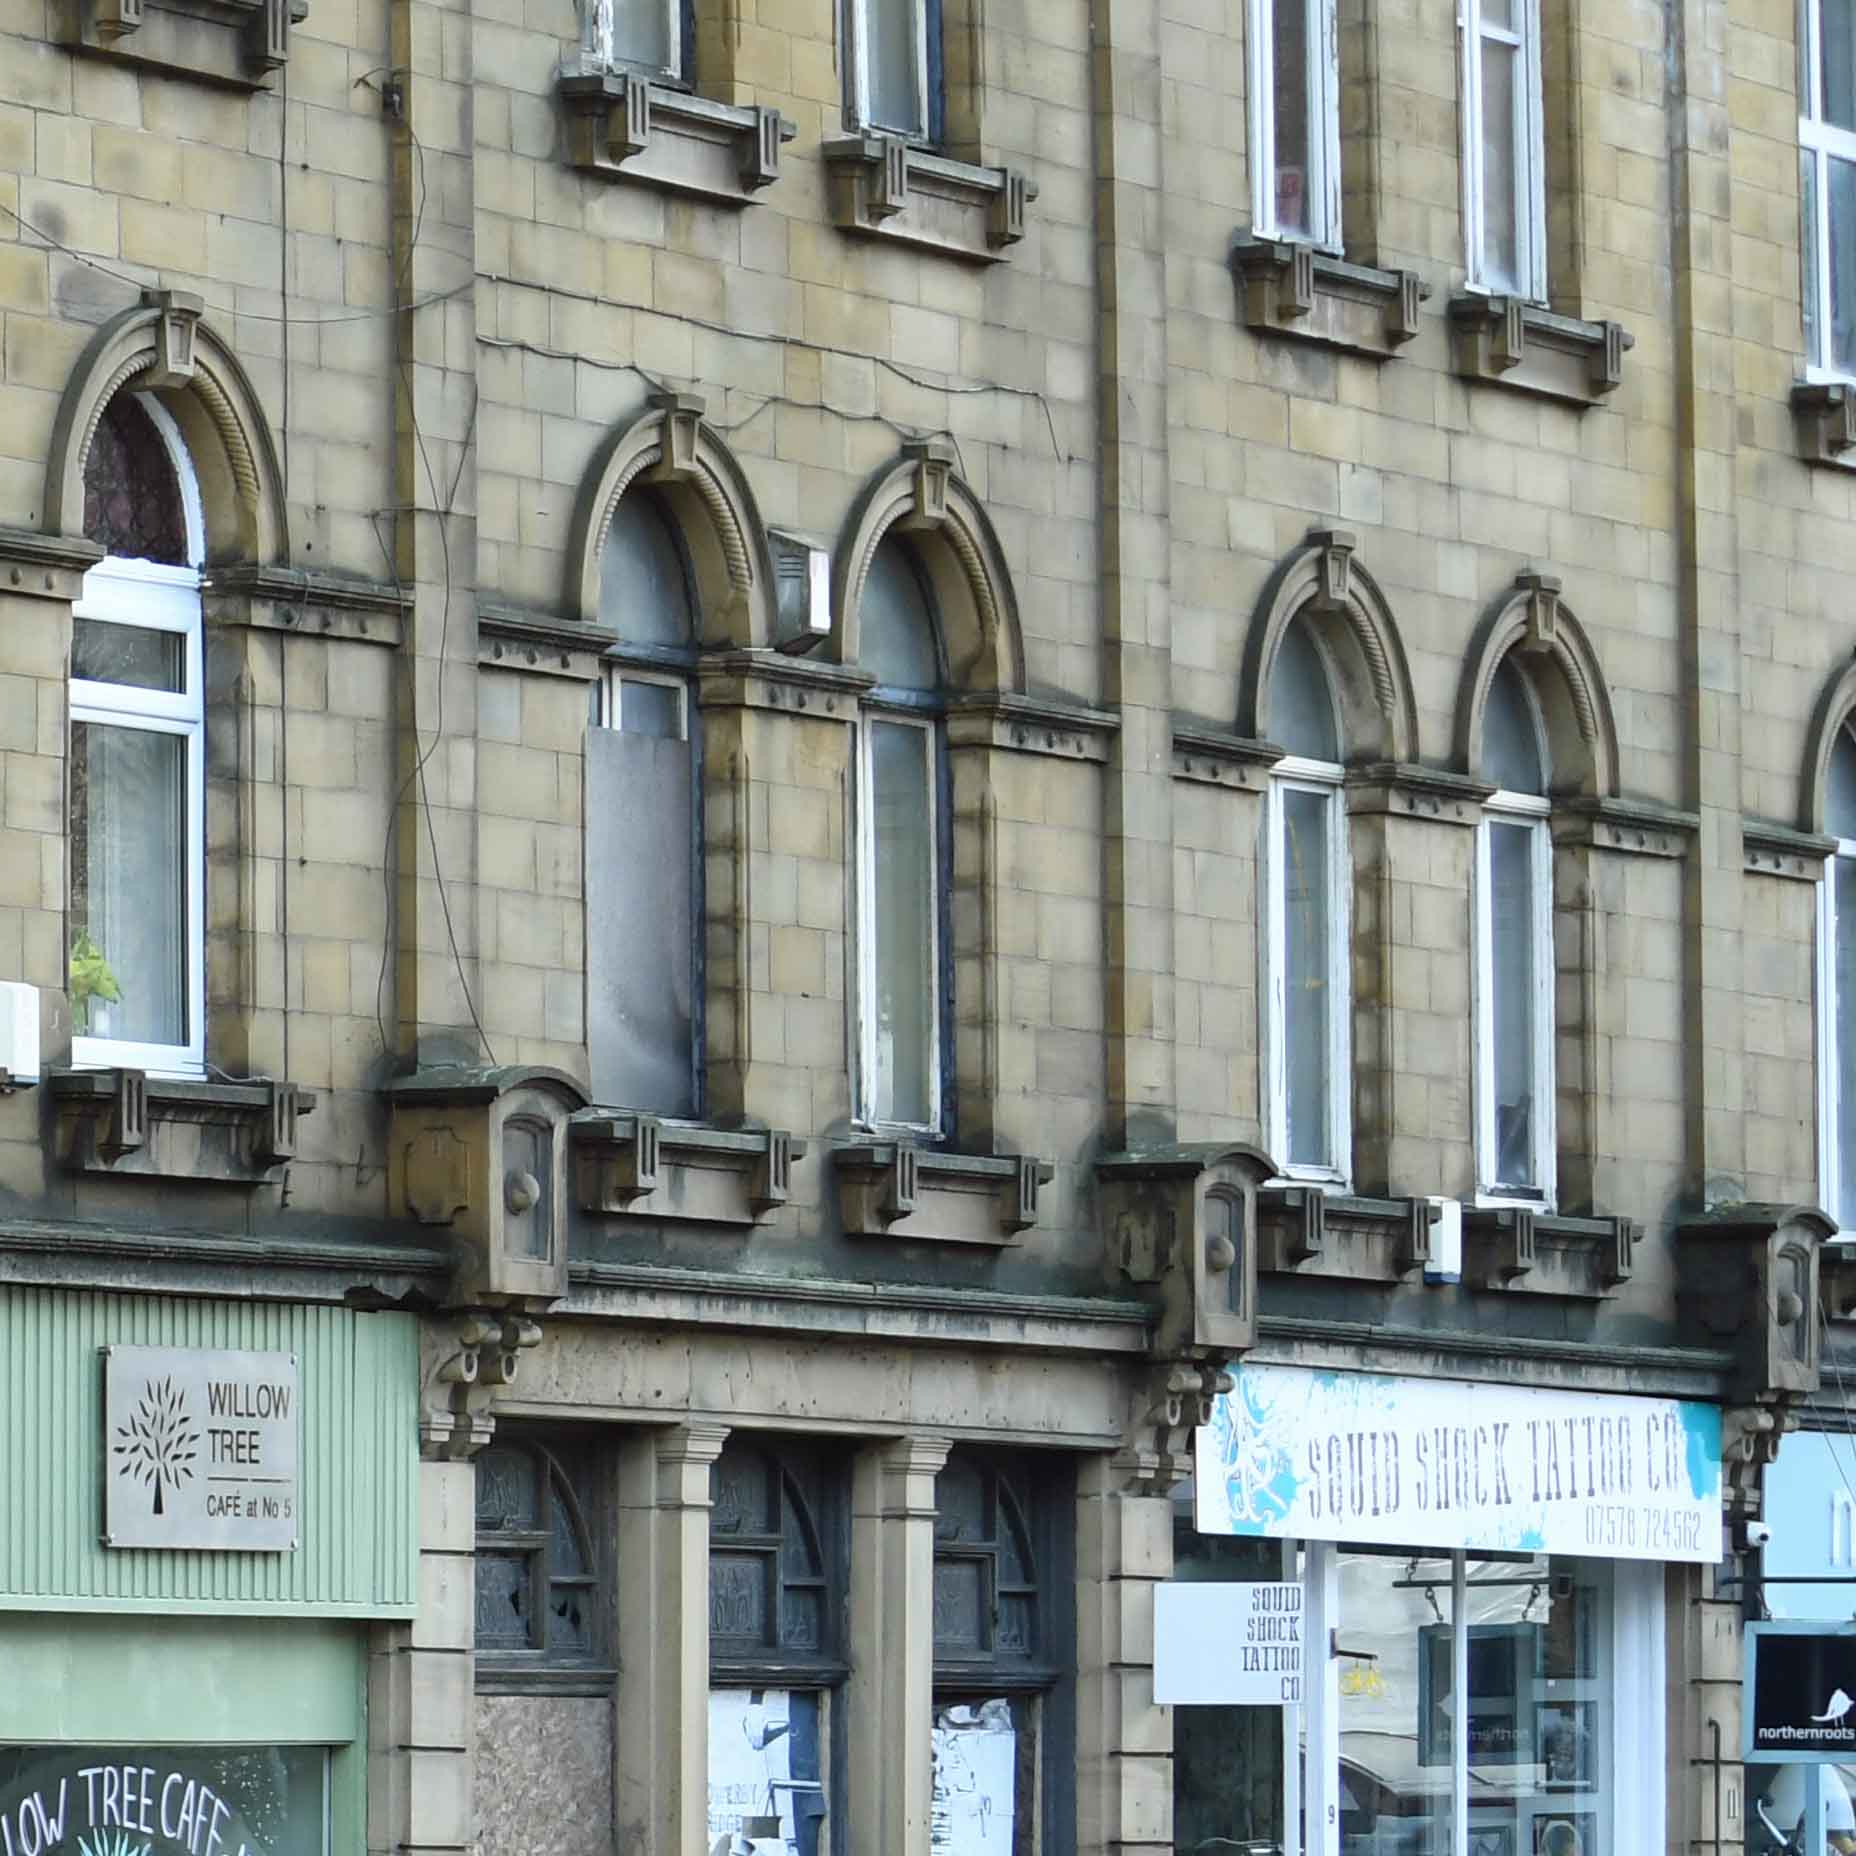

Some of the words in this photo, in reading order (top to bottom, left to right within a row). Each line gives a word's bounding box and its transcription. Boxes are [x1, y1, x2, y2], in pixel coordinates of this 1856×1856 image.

[208, 1381, 291, 1419] WILLOW
[207, 1429, 260, 1464] TREE
[1308, 1432, 1401, 1524] SQUID
[1415, 1421, 1513, 1512] SHOCK
[1527, 1415, 1633, 1503] TATTOO
[1645, 1411, 1680, 1493] CO
[207, 1489, 241, 1517] CAFÉ
[246, 1497, 258, 1518] at
[263, 1497, 279, 1518] No
[284, 1498, 292, 1518] 5
[1252, 1586, 1301, 1612] SQUID
[1247, 1615, 1300, 1641] SHOCK
[1240, 1646, 1300, 1671] TATTOO
[1281, 1676, 1300, 1701] CO
[1759, 1726, 1855, 1742] northernroots
[77, 1766, 156, 1834] TREE
[1328, 1804, 1335, 1825] 9
